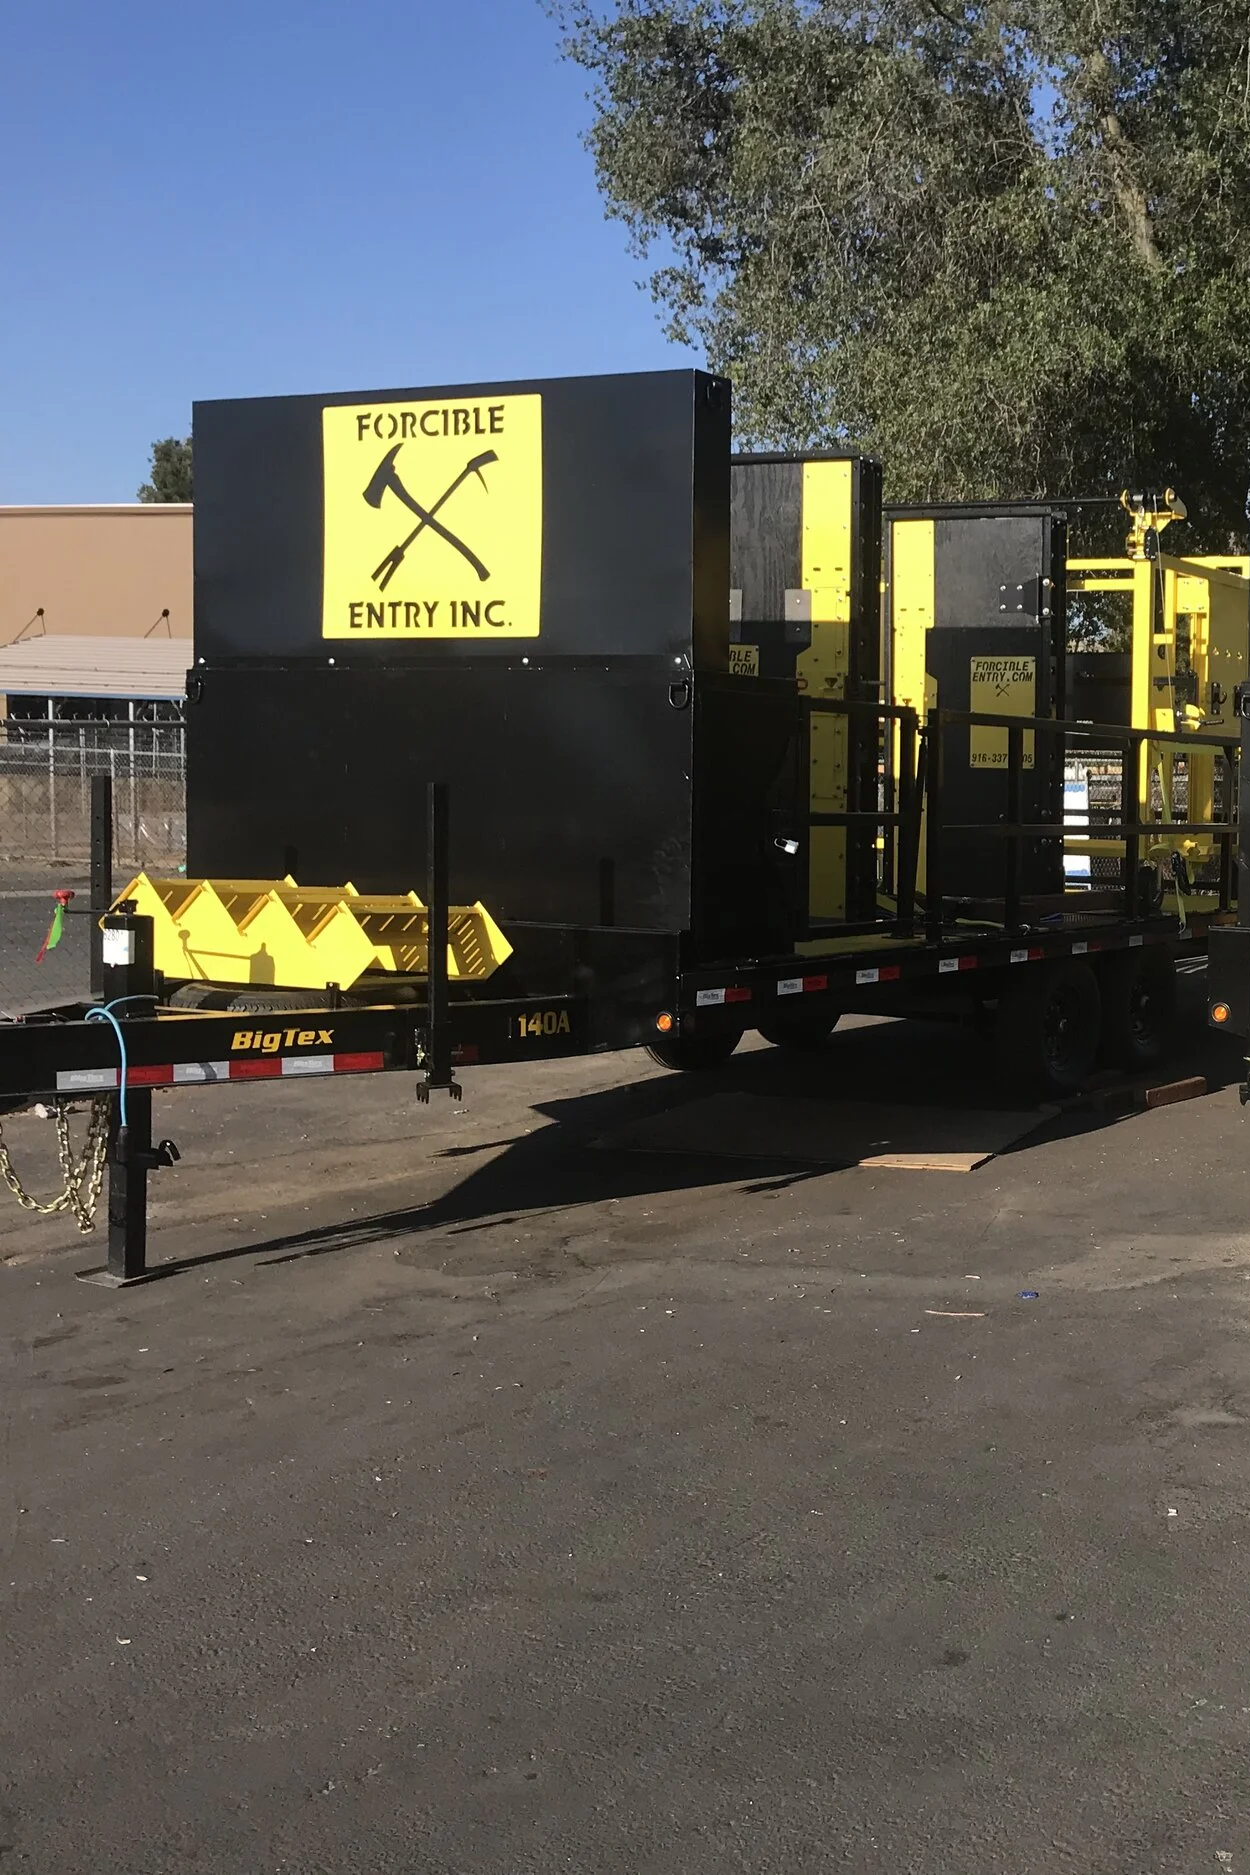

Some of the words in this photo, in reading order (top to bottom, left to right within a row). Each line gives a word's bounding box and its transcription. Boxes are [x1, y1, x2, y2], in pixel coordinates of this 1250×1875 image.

[356, 405, 505, 441] FORCIBLE
[349, 600, 439, 628] ENTRY
[450, 600, 512, 628] INC.
[972, 671, 1033, 682] ENTRY.COM
[975, 661, 1030, 671] FORCIBLE
[518, 1010, 571, 1037] 140A
[231, 1028, 334, 1053] BigTex
